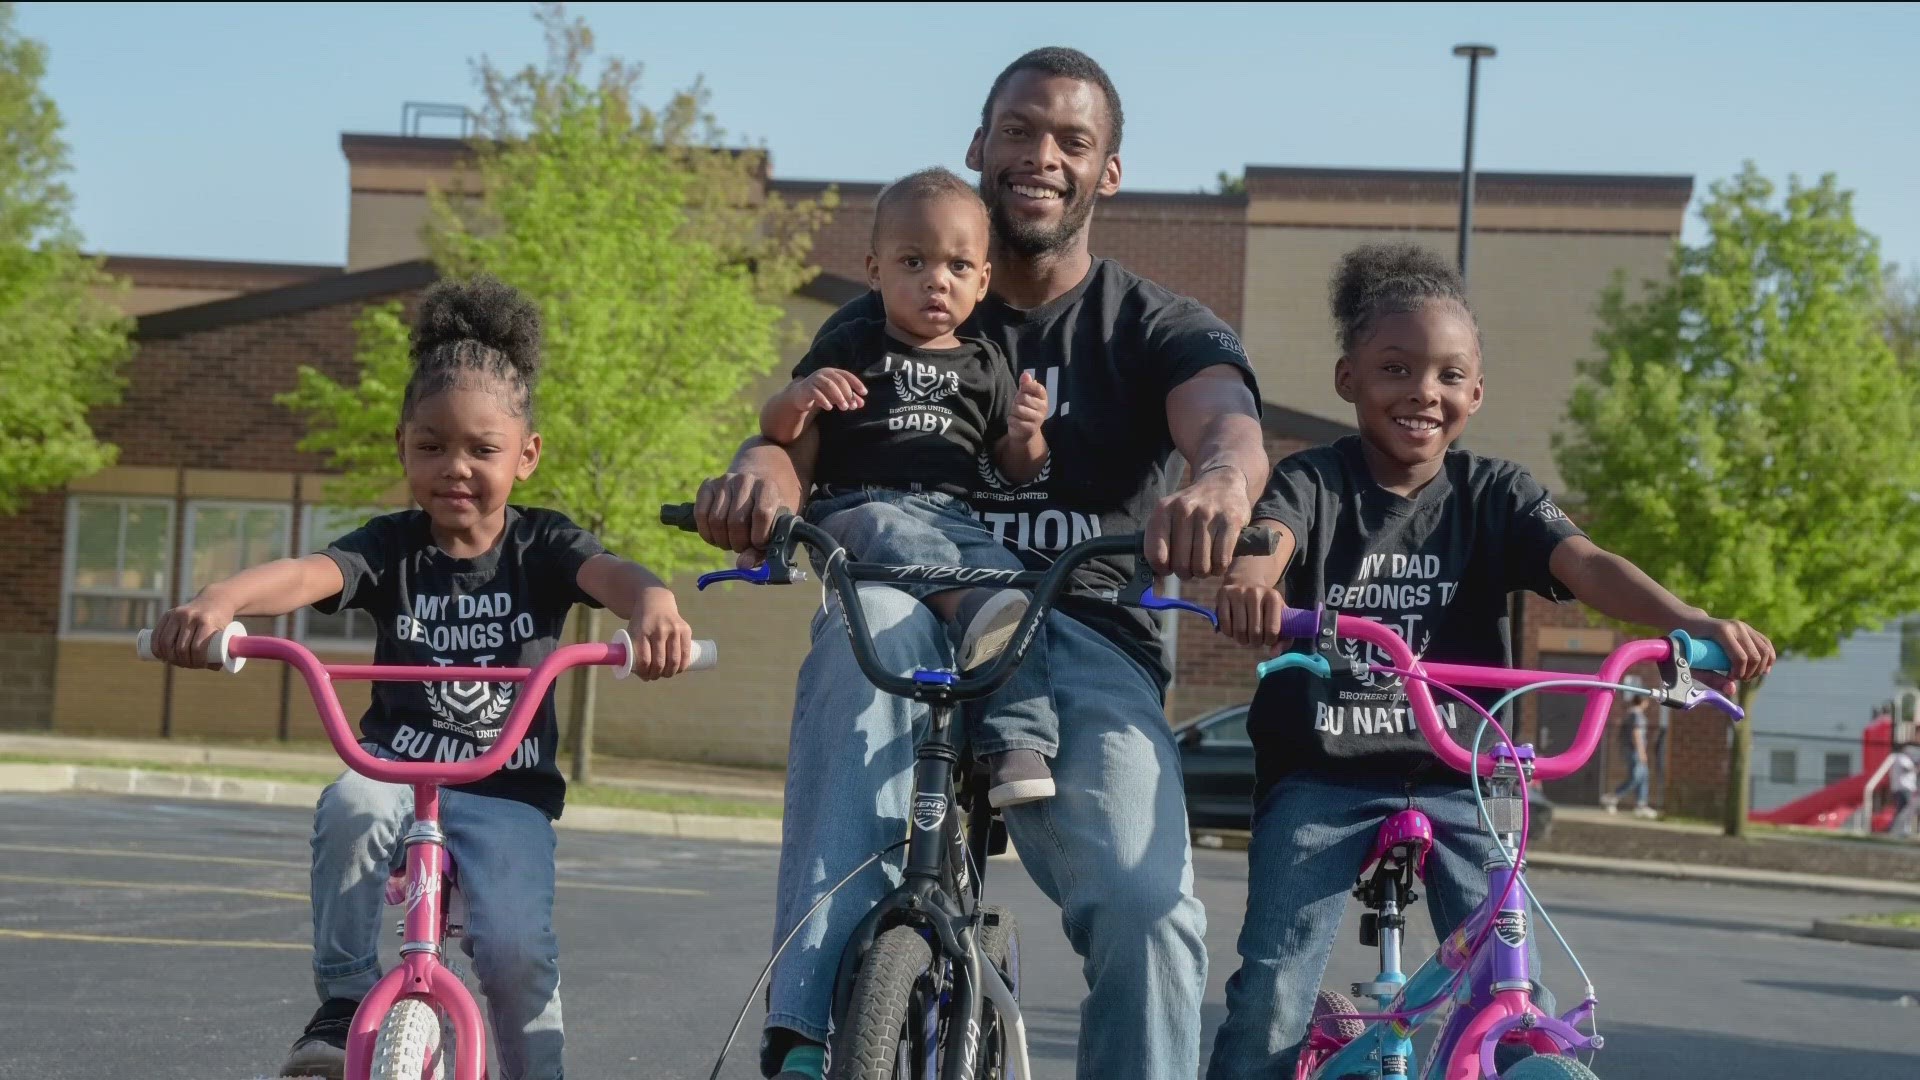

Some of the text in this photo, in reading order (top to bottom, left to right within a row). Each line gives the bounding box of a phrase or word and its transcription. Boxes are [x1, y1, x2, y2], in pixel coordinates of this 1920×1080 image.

[889, 404, 953, 415] BROTHERS UNITED
[888, 412, 953, 435] BABY
[972, 490, 1049, 502] BROTHERS UNITED
[972, 509, 1102, 550] TION
[1392, 554, 1440, 579] DAD
[414, 592, 512, 621] MY DAD
[1325, 584, 1431, 610] BELONGS
[396, 612, 534, 652] BELONGS TO
[1018, 606, 1044, 658] KENT
[1338, 691, 1388, 701] BROTHERS
[432, 719, 504, 739] BROTHERS UNIT
[1314, 701, 1458, 736] BU NATIN
[391, 724, 540, 770] BU NAON
[914, 800, 945, 809] KENT
